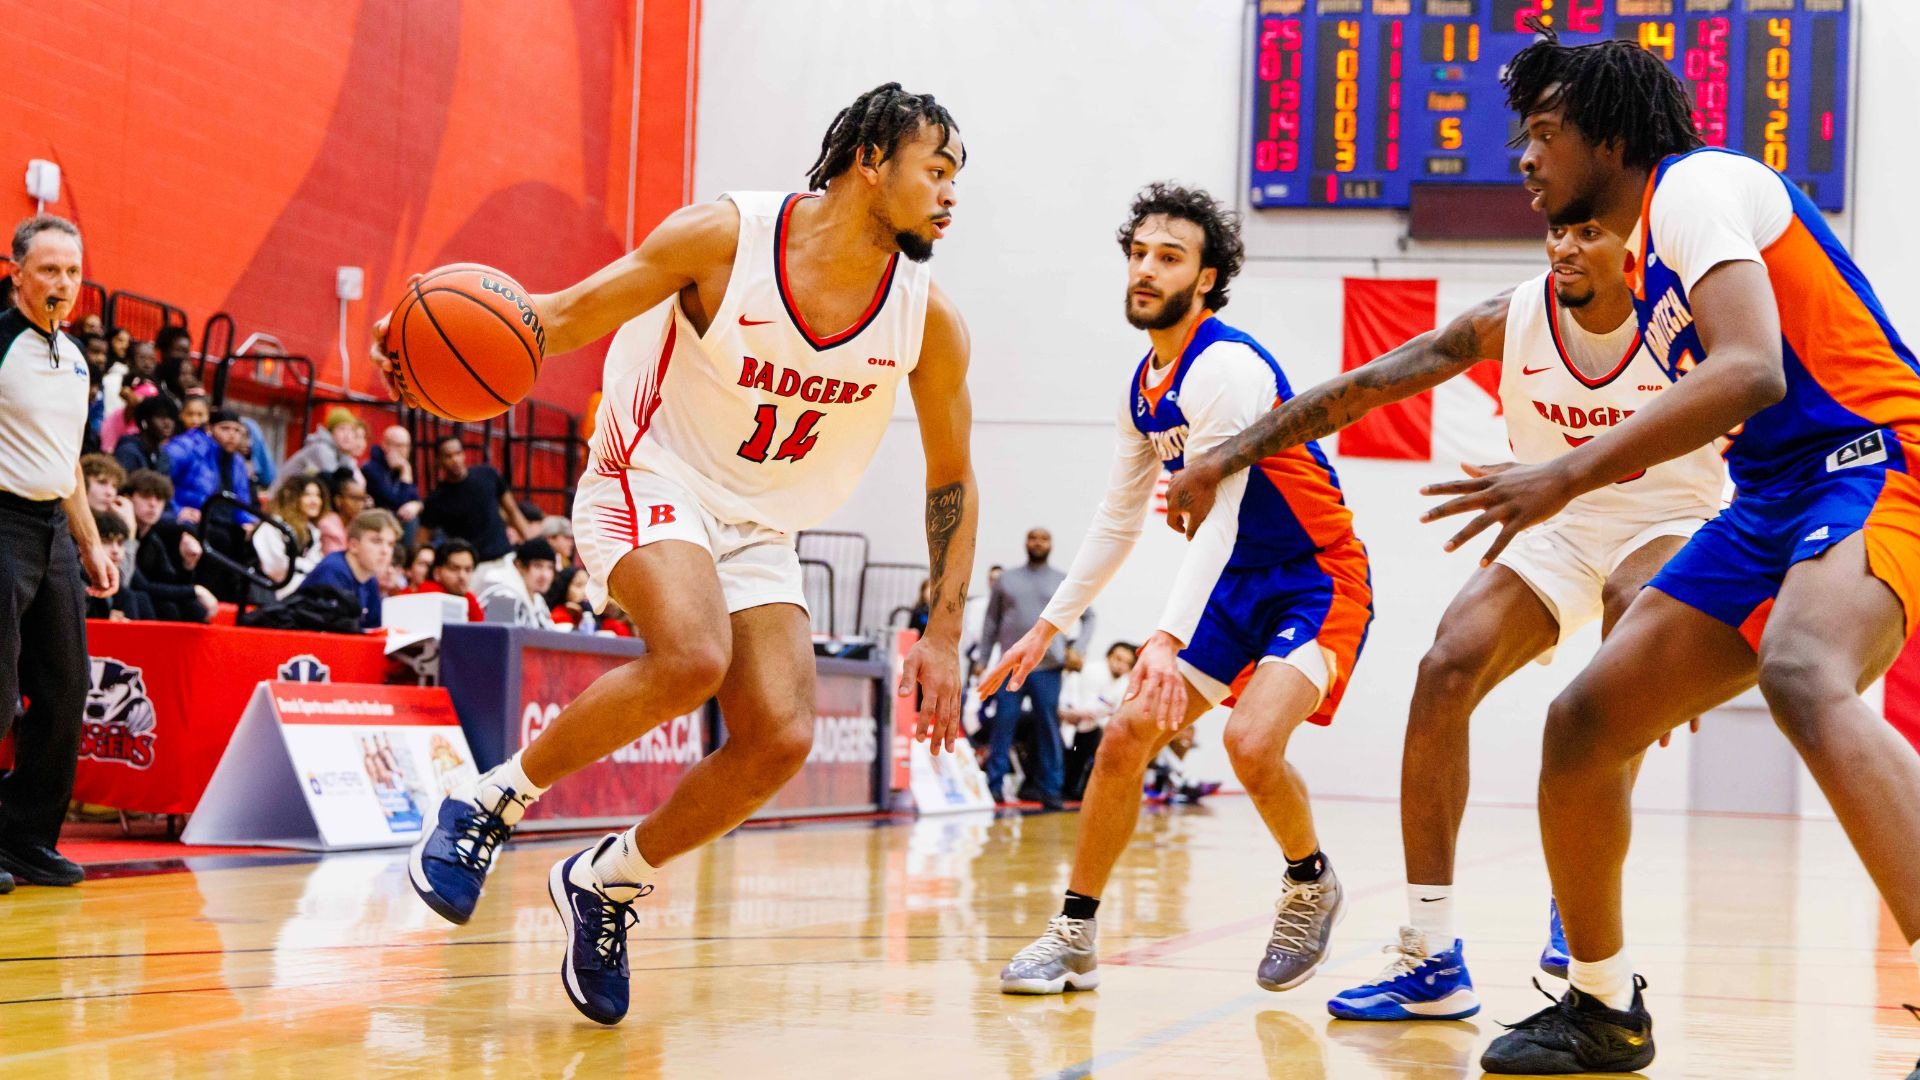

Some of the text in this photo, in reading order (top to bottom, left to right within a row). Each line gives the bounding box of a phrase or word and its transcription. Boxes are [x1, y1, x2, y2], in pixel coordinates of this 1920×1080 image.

[1260, 19, 1402, 50] 25 4 1
[1443, 24, 1479, 62] 11
[1638, 22, 1675, 61] 14
[1698, 17, 1791, 48] 12 4
[1336, 49, 1358, 81] 0
[1390, 51, 1401, 79] 1
[1685, 47, 1790, 80] 05 0
[1269, 80, 1400, 111] 13 0 1
[1765, 80, 1789, 109] 4
[1334, 111, 1357, 142] 0
[1387, 111, 1399, 140] 1
[1440, 117, 1462, 149] 5
[1764, 110, 1788, 142] 2
[1821, 111, 1833, 141] 1
[1256, 140, 1298, 172] 03
[1335, 141, 1356, 173] 3
[1386, 142, 1398, 171] 1
[1326, 174, 1337, 203] 1
[867, 357, 896, 367] OUA
[737, 356, 877, 404] BADGERS
[1532, 400, 1636, 429] BADGE
[736, 404, 827, 464] 14
[647, 504, 676, 527] B
[806, 716, 878, 763] ADGERS
